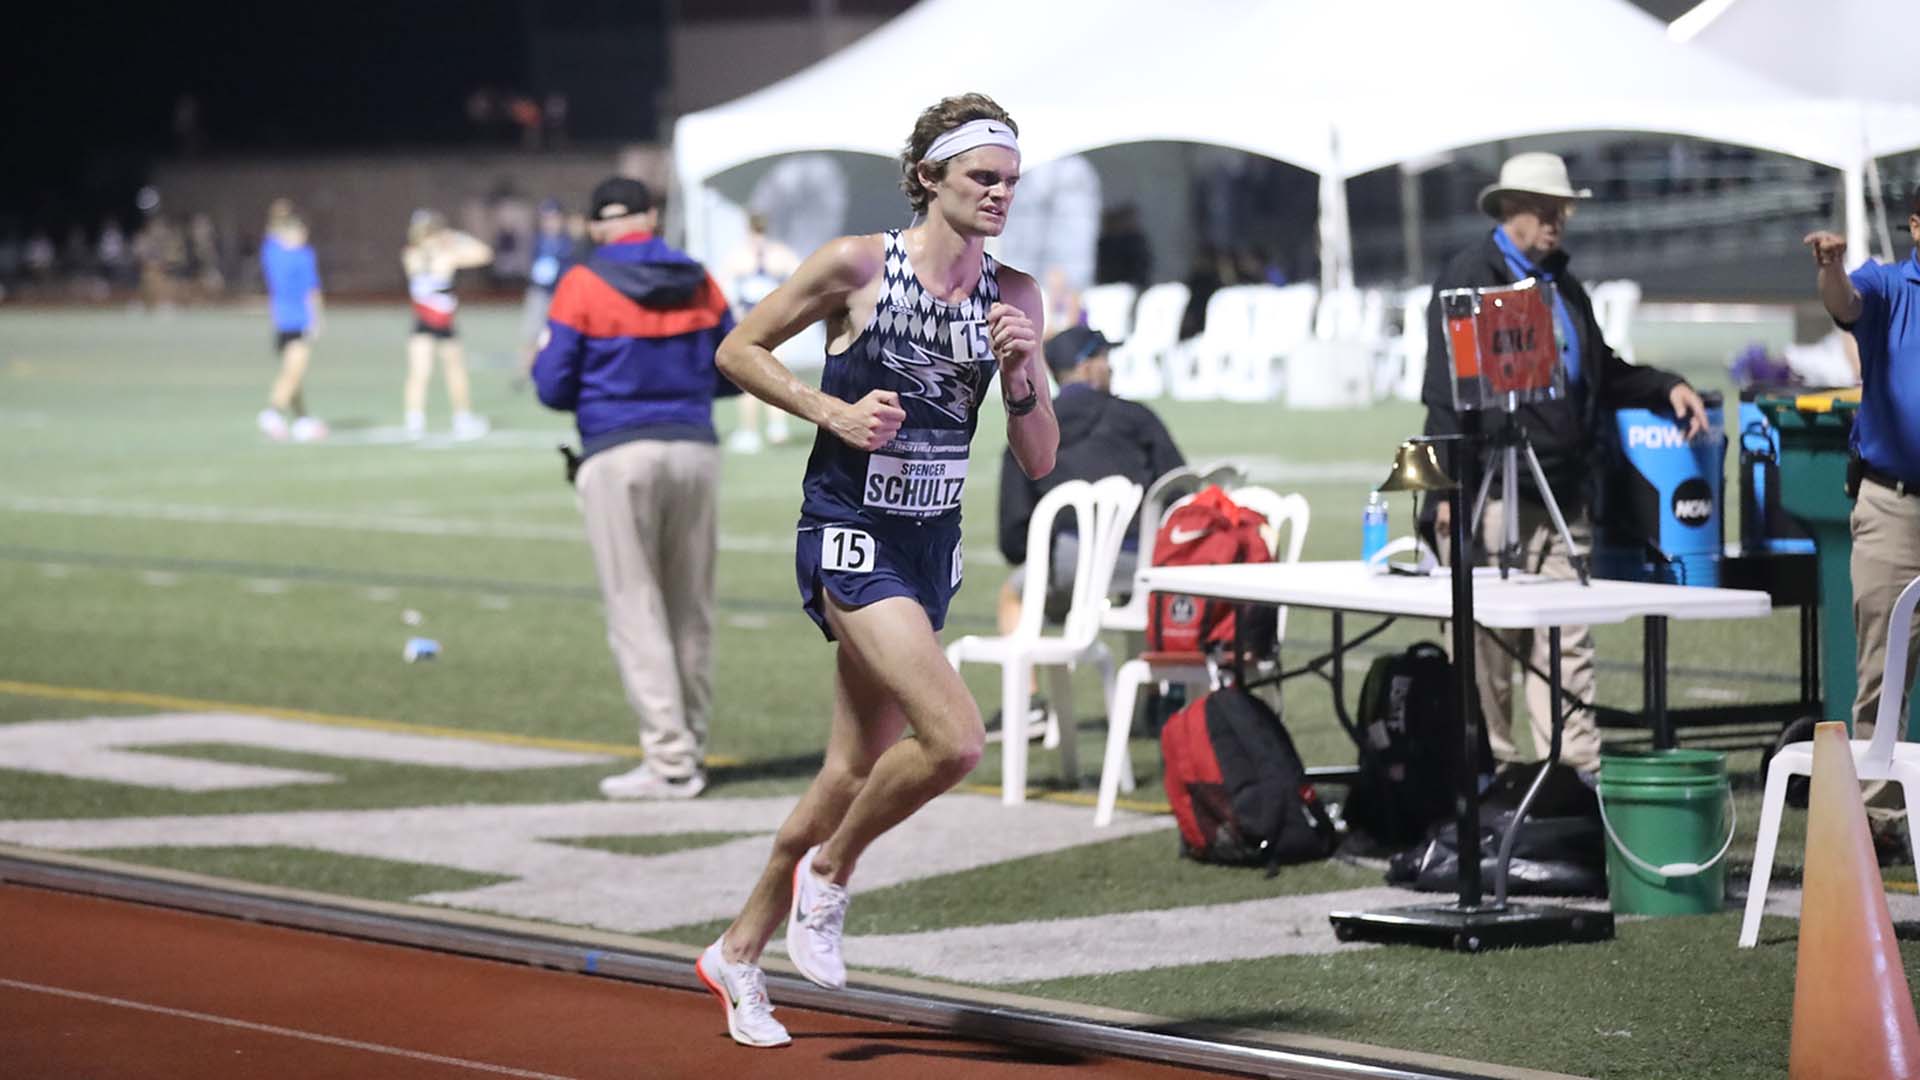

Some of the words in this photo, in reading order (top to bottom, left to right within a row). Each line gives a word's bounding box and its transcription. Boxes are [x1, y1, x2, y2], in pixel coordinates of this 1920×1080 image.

[960, 320, 989, 359] 15
[901, 463, 946, 476] SPENCER
[867, 473, 965, 505] SCHULTZ
[832, 531, 866, 569] 15
